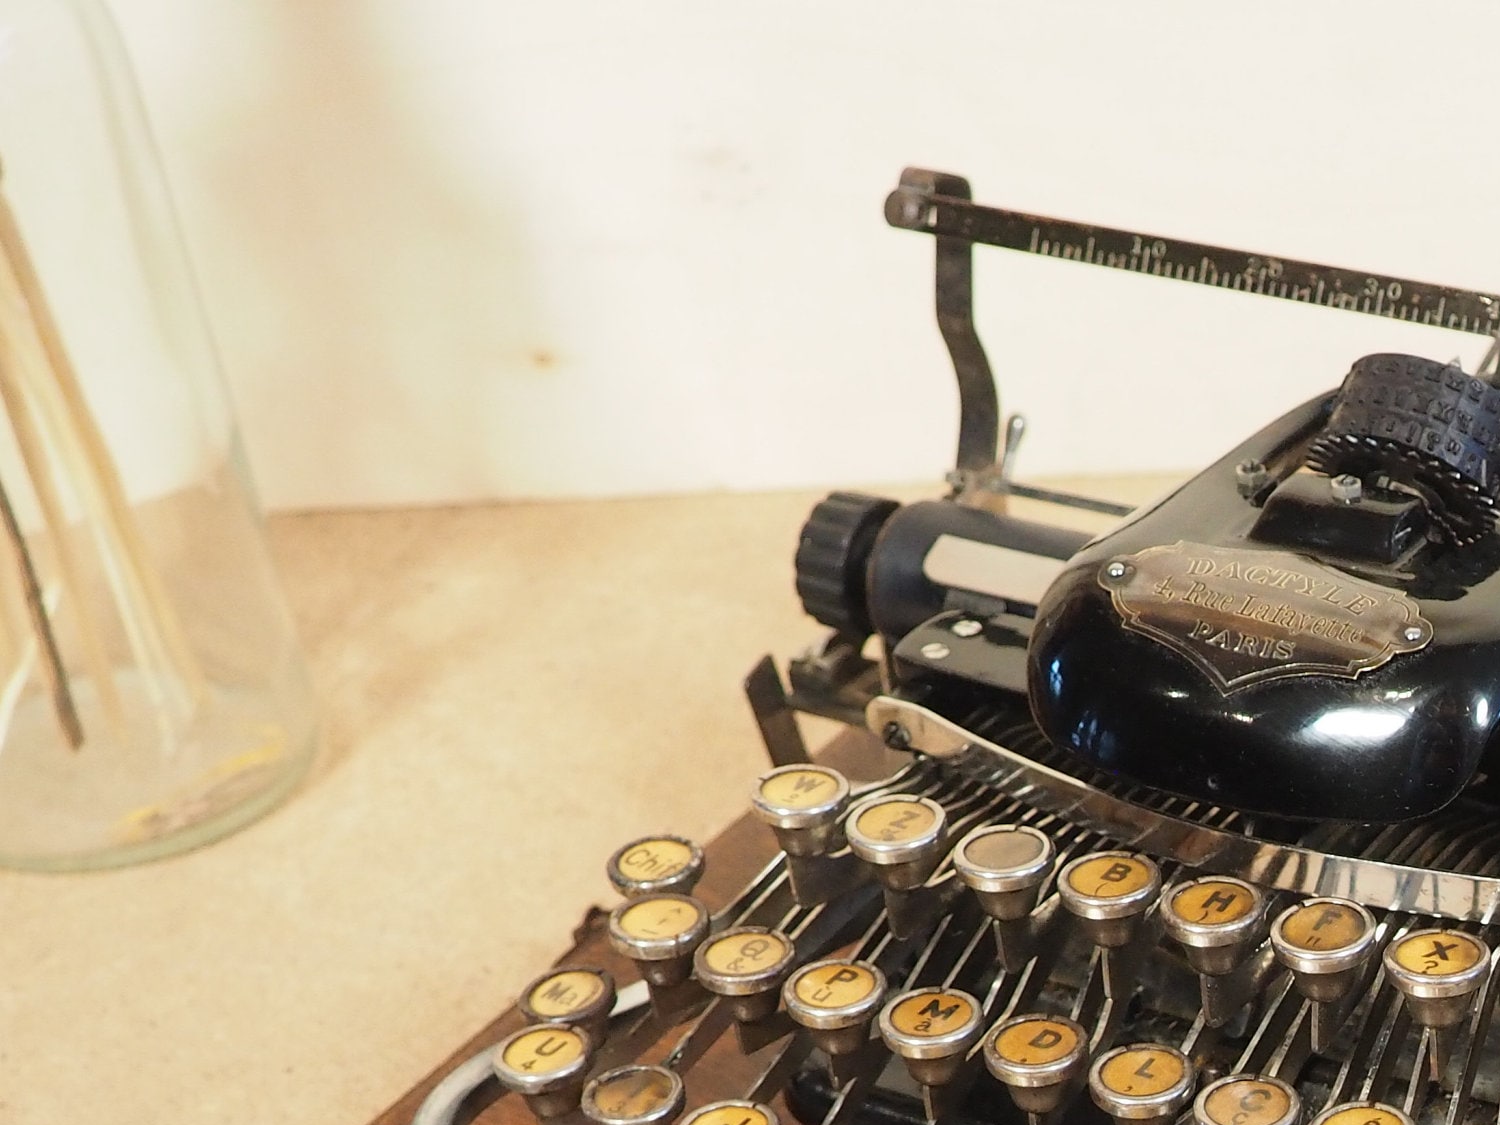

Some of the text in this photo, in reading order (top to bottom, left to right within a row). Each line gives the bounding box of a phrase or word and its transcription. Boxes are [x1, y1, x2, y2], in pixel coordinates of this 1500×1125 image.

[1364, 278, 1402, 301] 30
[1188, 557, 1377, 617] DACTYLE
[1182, 581, 1234, 610] Rue
[1236, 595, 1365, 644] Lafayette
[1188, 619, 1297, 660] PARIS
[1101, 862, 1132, 882] B
[1202, 891, 1237, 912] H
[1313, 910, 1342, 931] F
[741, 939, 769, 960] Q
[1422, 941, 1458, 961] X
[825, 968, 858, 985] P
[919, 999, 960, 1020] M
[535, 1037, 567, 1056] U
[1028, 1028, 1062, 1049] D
[522, 1060, 537, 1071] 4
[1134, 1058, 1155, 1079] L
[1240, 1089, 1271, 1112] C
